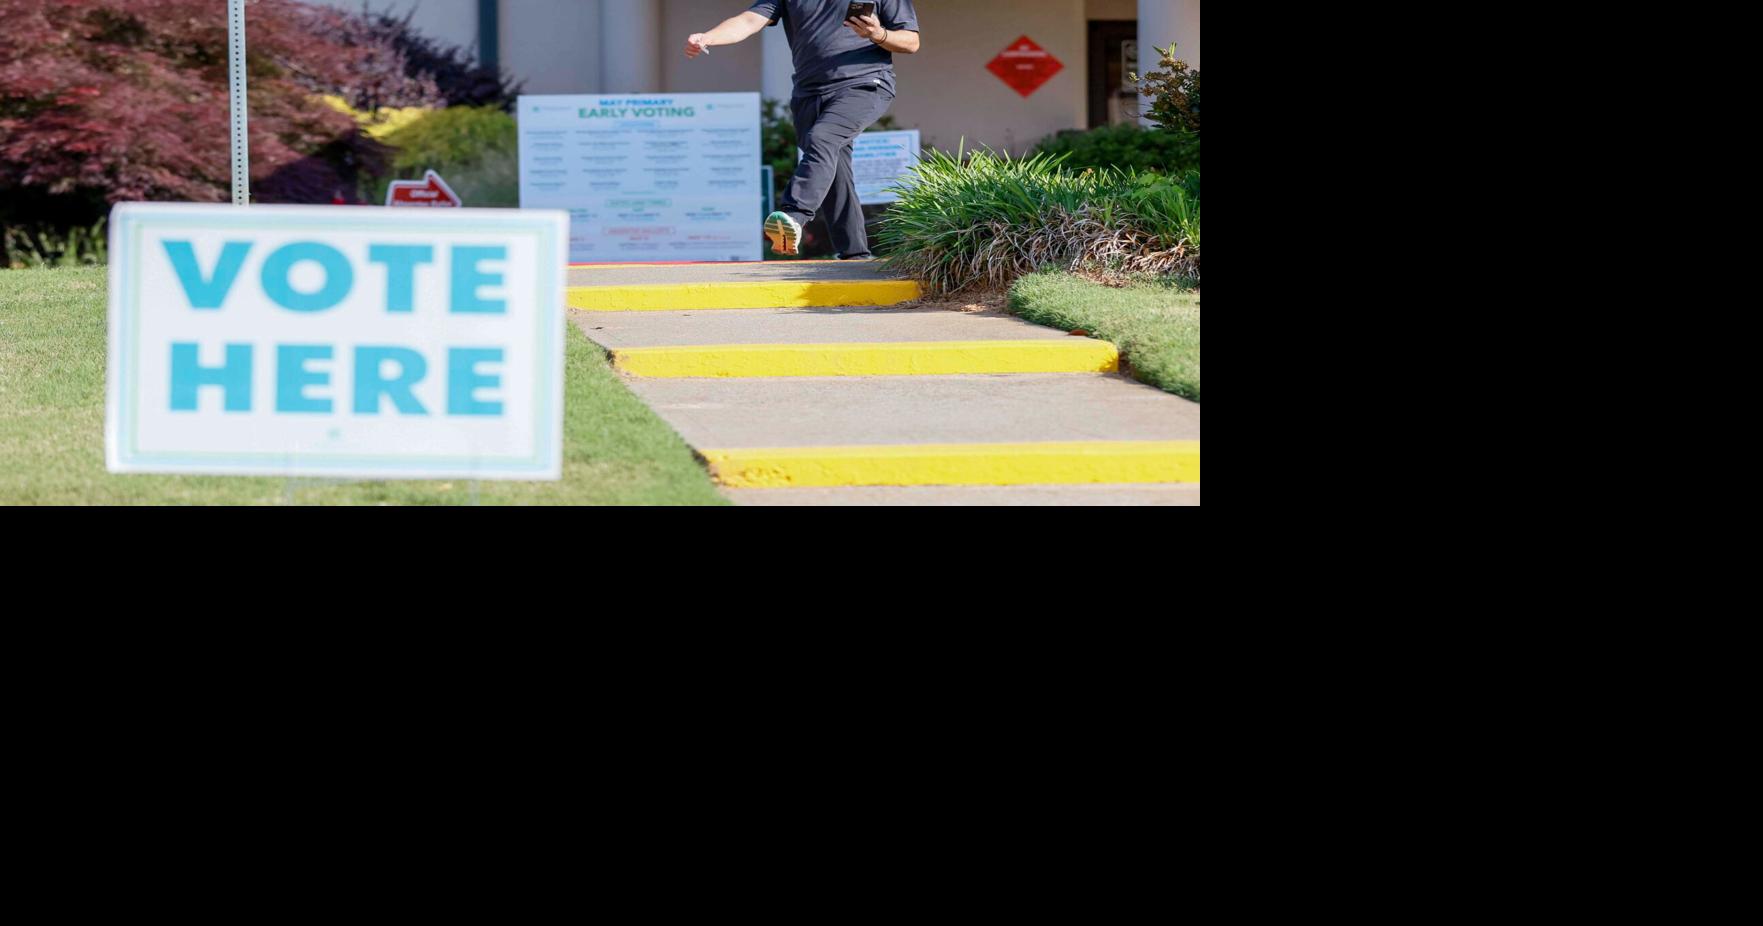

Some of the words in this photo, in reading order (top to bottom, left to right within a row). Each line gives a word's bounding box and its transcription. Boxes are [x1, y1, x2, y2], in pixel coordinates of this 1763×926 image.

[578, 107, 627, 119] EARLY
[630, 106, 696, 118] VOTING
[160, 239, 509, 315] VOTE
[167, 341, 506, 417] HERE
